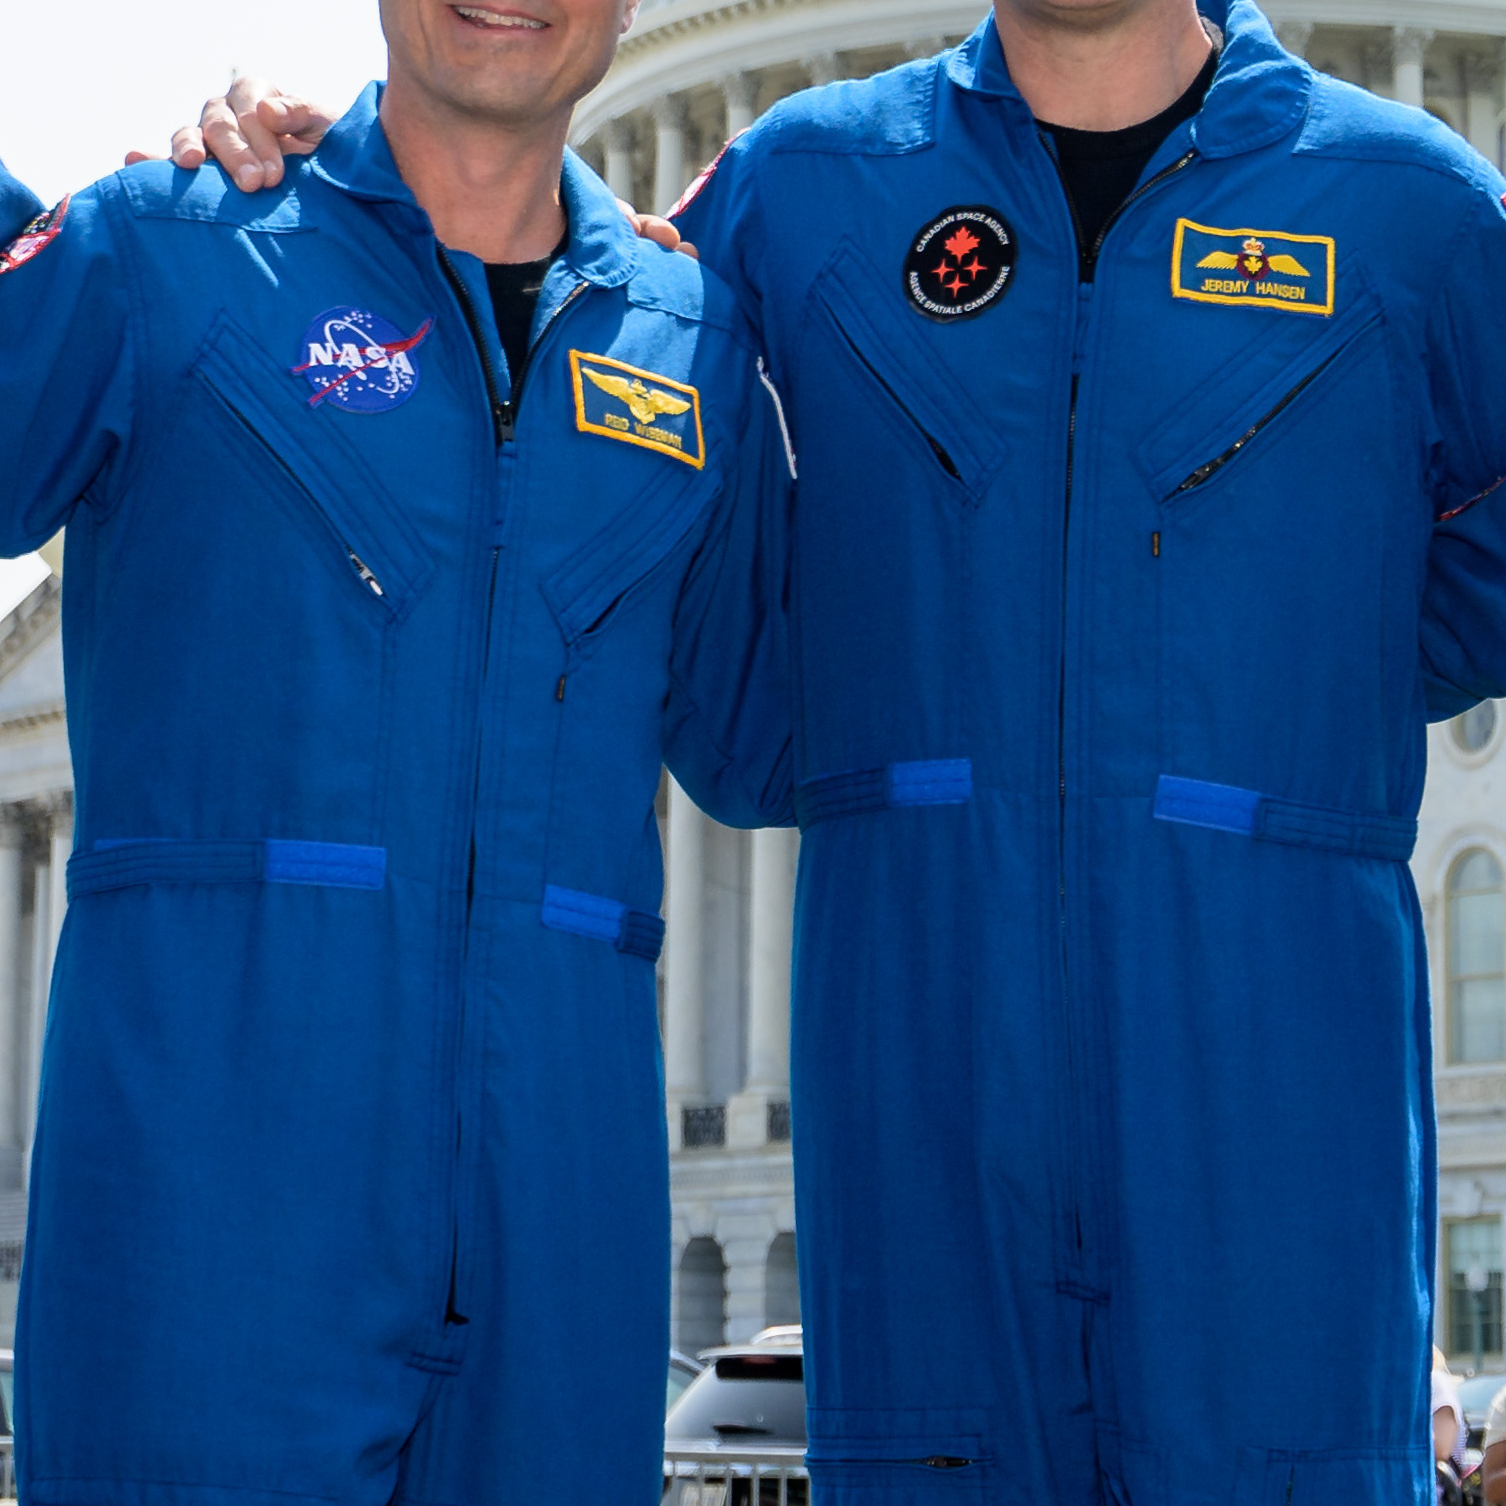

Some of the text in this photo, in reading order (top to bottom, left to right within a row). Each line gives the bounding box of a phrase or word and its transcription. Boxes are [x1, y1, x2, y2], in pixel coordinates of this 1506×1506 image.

[916, 212, 1010, 253] CANADIAN SPACE AGENCY
[1200, 278, 1306, 301] JEREMY HANSEN
[923, 300, 963, 315] SPATIALE
[308, 343, 415, 376] NASA
